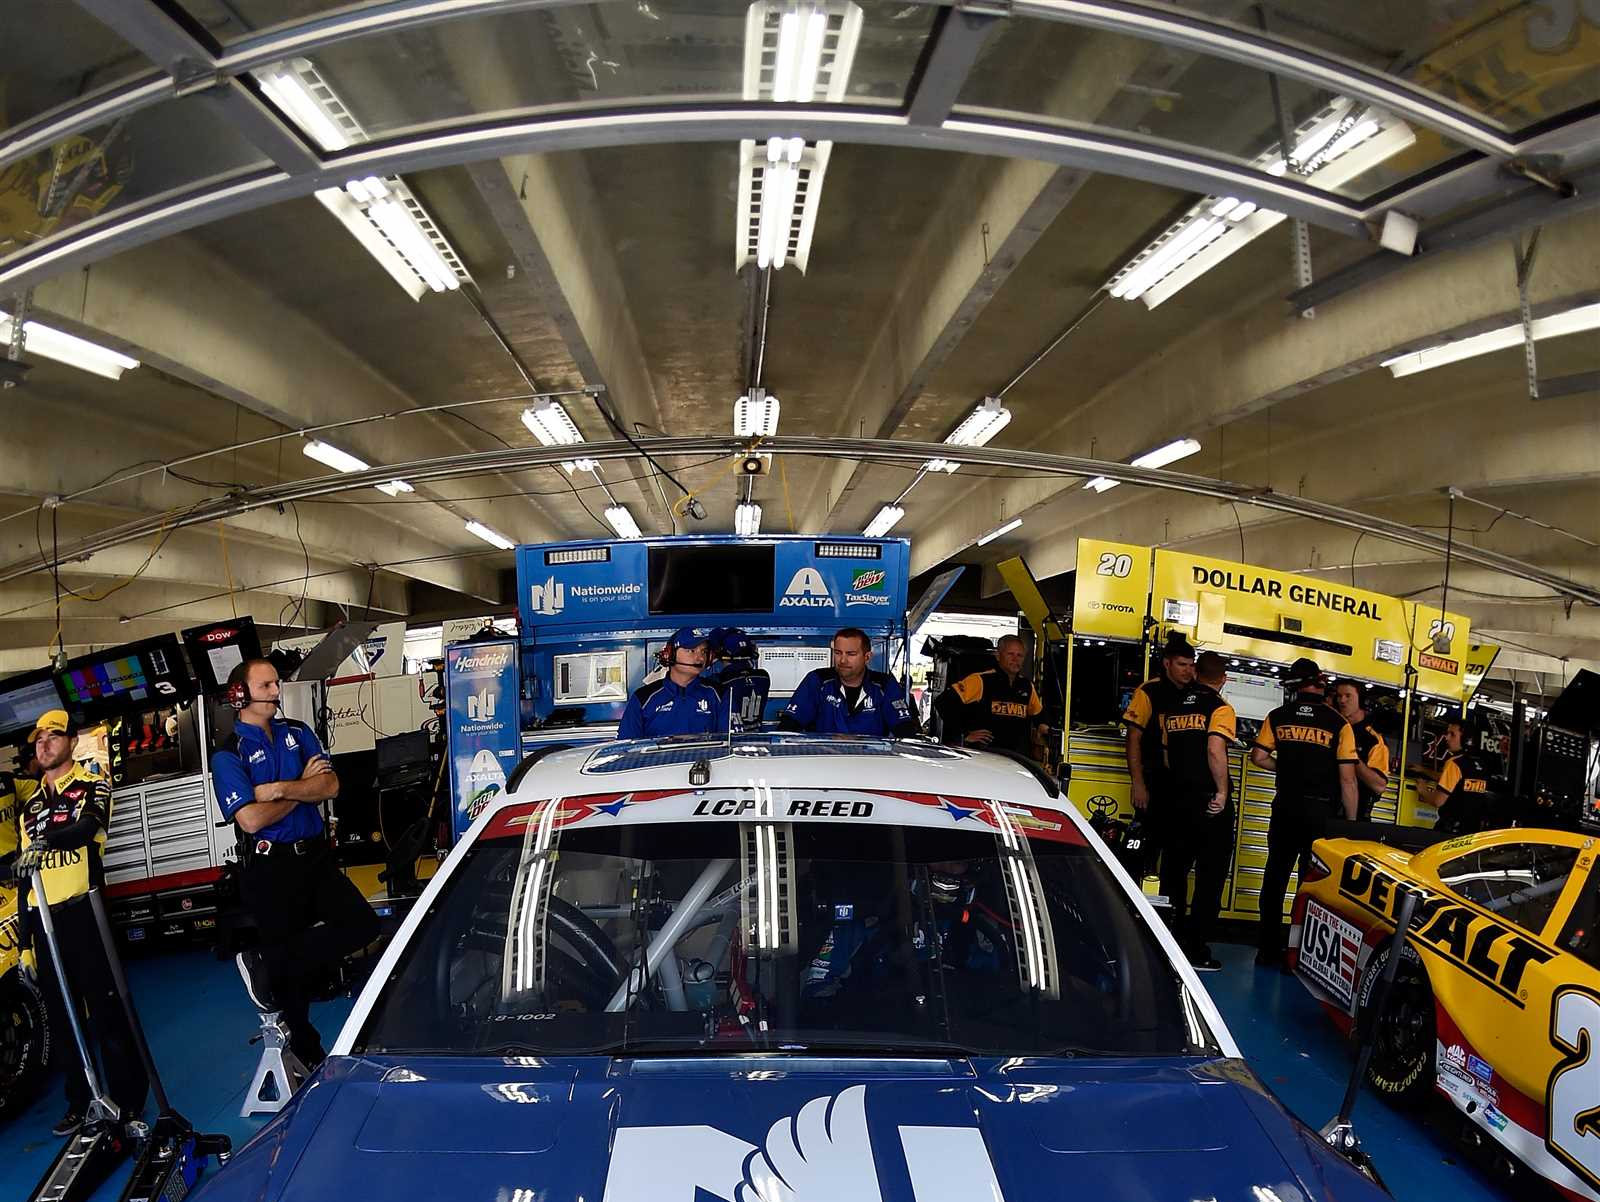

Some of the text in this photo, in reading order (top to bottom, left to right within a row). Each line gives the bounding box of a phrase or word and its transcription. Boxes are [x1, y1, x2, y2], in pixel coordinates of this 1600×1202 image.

[1097, 553, 1132, 578] 20
[571, 584, 641, 597] Nationwide
[1192, 566, 1382, 621] DOLLAR GENERAL
[779, 597, 835, 607] AXALTA
[1101, 603, 1135, 614] TOYOTA
[207, 631, 231, 641] DOW
[455, 653, 509, 672] Hendrick
[154, 681, 176, 695] 3
[461, 722, 504, 733] Nationwide
[786, 800, 874, 817] REED
[1126, 840, 1141, 849] 20
[1308, 902, 1323, 920] MADE
[1328, 914, 1340, 929] THE
[1303, 914, 1341, 975] USA
